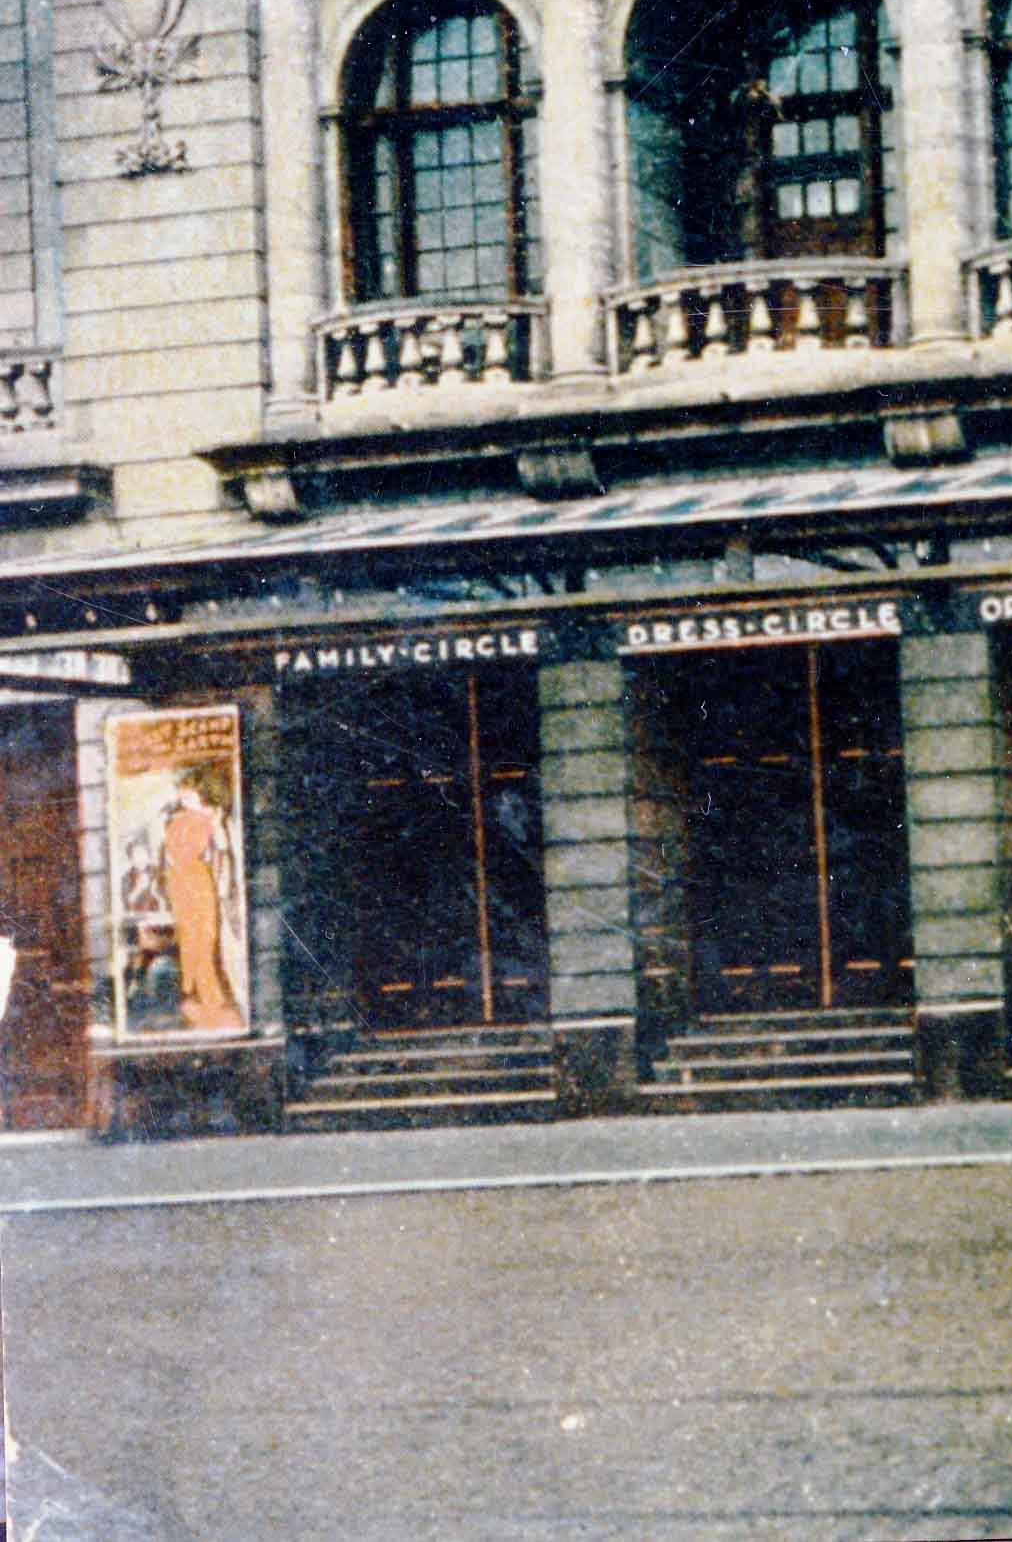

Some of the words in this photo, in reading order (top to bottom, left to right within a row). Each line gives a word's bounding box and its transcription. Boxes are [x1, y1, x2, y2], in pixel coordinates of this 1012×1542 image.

[627, 617, 741, 645] DRESS
[763, 602, 900, 635] CIRCLE
[274, 643, 395, 672] FAMILY
[413, 630, 539, 663] CIRCLE
